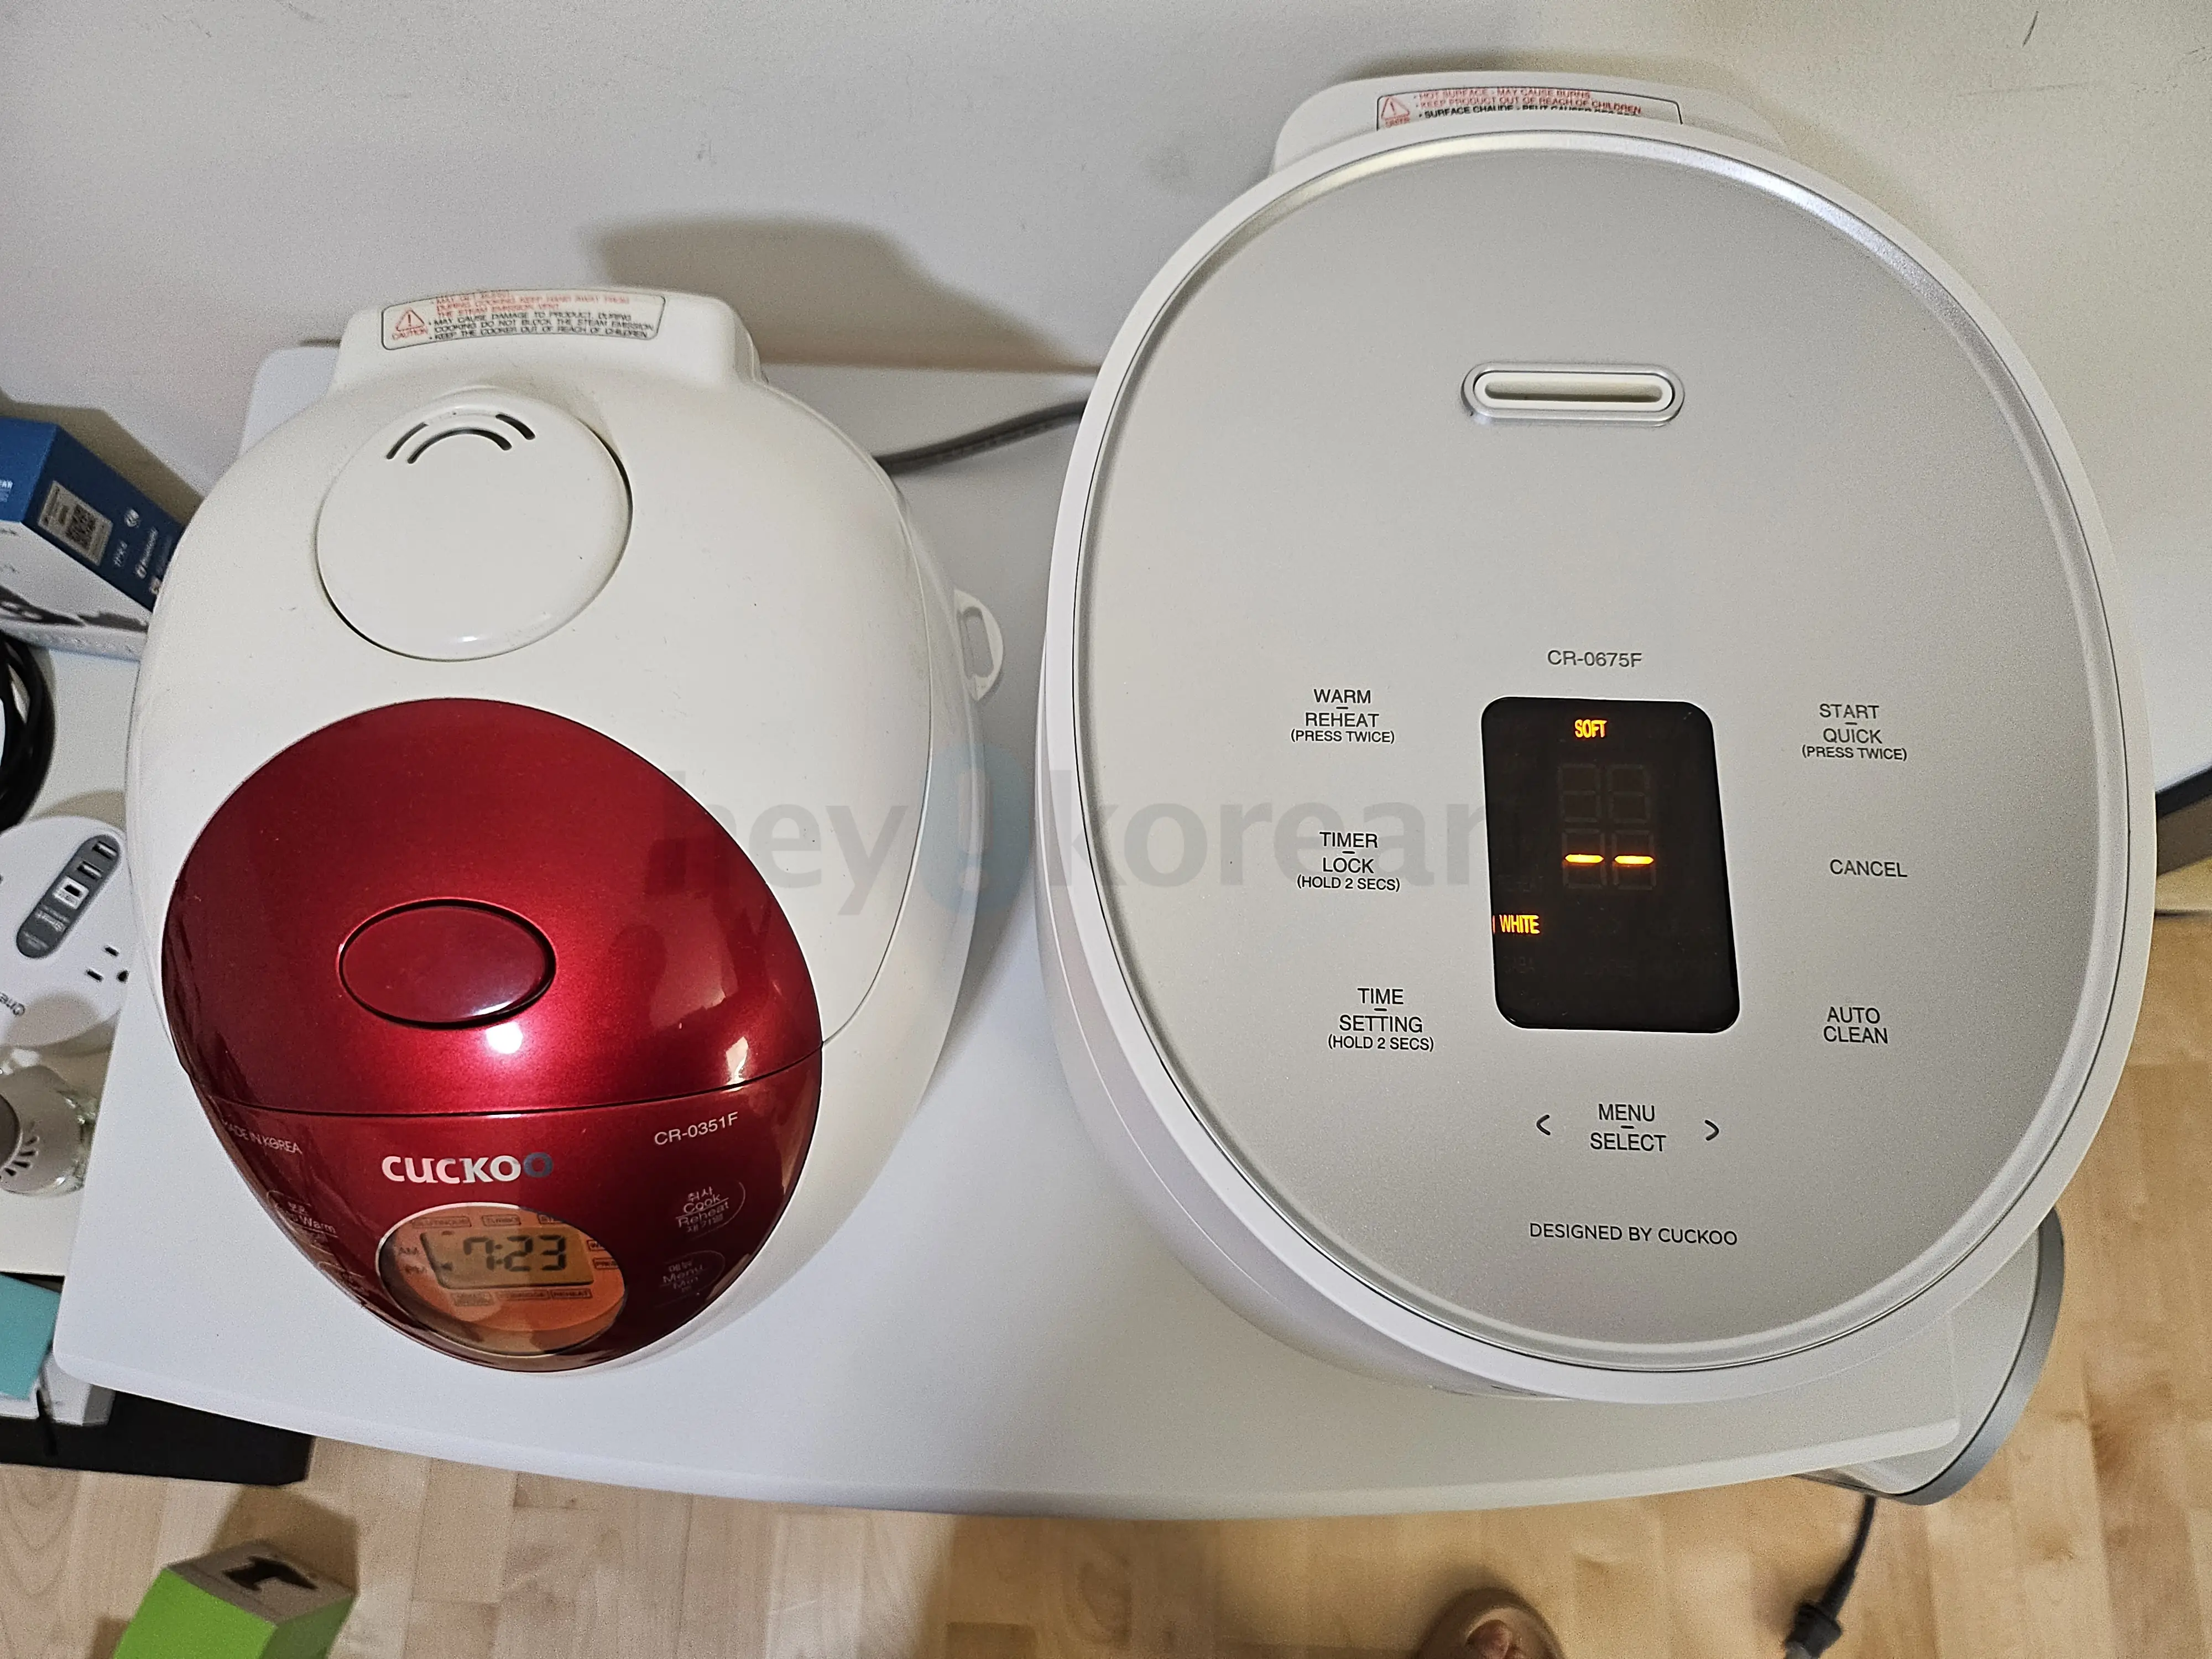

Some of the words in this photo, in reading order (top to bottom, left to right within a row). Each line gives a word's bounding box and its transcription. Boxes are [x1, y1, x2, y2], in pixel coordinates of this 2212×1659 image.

[1424, 106, 1472, 119] SURFACE
[1547, 649, 1642, 667] CR-0675F
[1313, 688, 1371, 703] WARM
[1305, 712, 1380, 727] REHEAT
[1819, 703, 1880, 719] START
[1291, 728, 1343, 743] (PRESS
[1348, 731, 1395, 744] TWICE)
[1574, 719, 1608, 738] SOFT
[1823, 728, 1883, 744] QUICK
[1802, 744, 1854, 759] (PRESS
[1856, 747, 1907, 761] TWICE)
[1319, 831, 1378, 848] TIMER
[1322, 857, 1375, 874] LOCK
[1829, 859, 1908, 878] CANCEL
[1297, 874, 1342, 889] (HOLD
[1344, 878, 1354, 889] 2
[1357, 878, 1401, 893] SECS)
[1499, 914, 1541, 935] WHITE
[1357, 987, 1404, 1005] TIME
[1339, 1014, 1423, 1033] SETTING
[1827, 1006, 1880, 1024] AUTO
[1328, 1034, 1373, 1050] (HOLD
[1376, 1037, 1386, 1050] 2
[1389, 1036, 1434, 1052] SECS)
[1823, 1025, 1888, 1045] CLEAN
[1598, 1103, 1655, 1122] MENU
[654, 1111, 739, 1146] CR-0351F
[262, 1135, 303, 1155] KOREA
[1590, 1132, 1667, 1152] SELECT
[683, 1194, 721, 1214] Cook
[678, 1201, 729, 1228] Reheat
[1530, 1222, 1623, 1240] DESIGNED
[1629, 1226, 1652, 1241] BY
[1658, 1228, 1738, 1245] CUCKOO
[463, 1234, 566, 1271] 7:23
[662, 1264, 703, 1284] Menu
